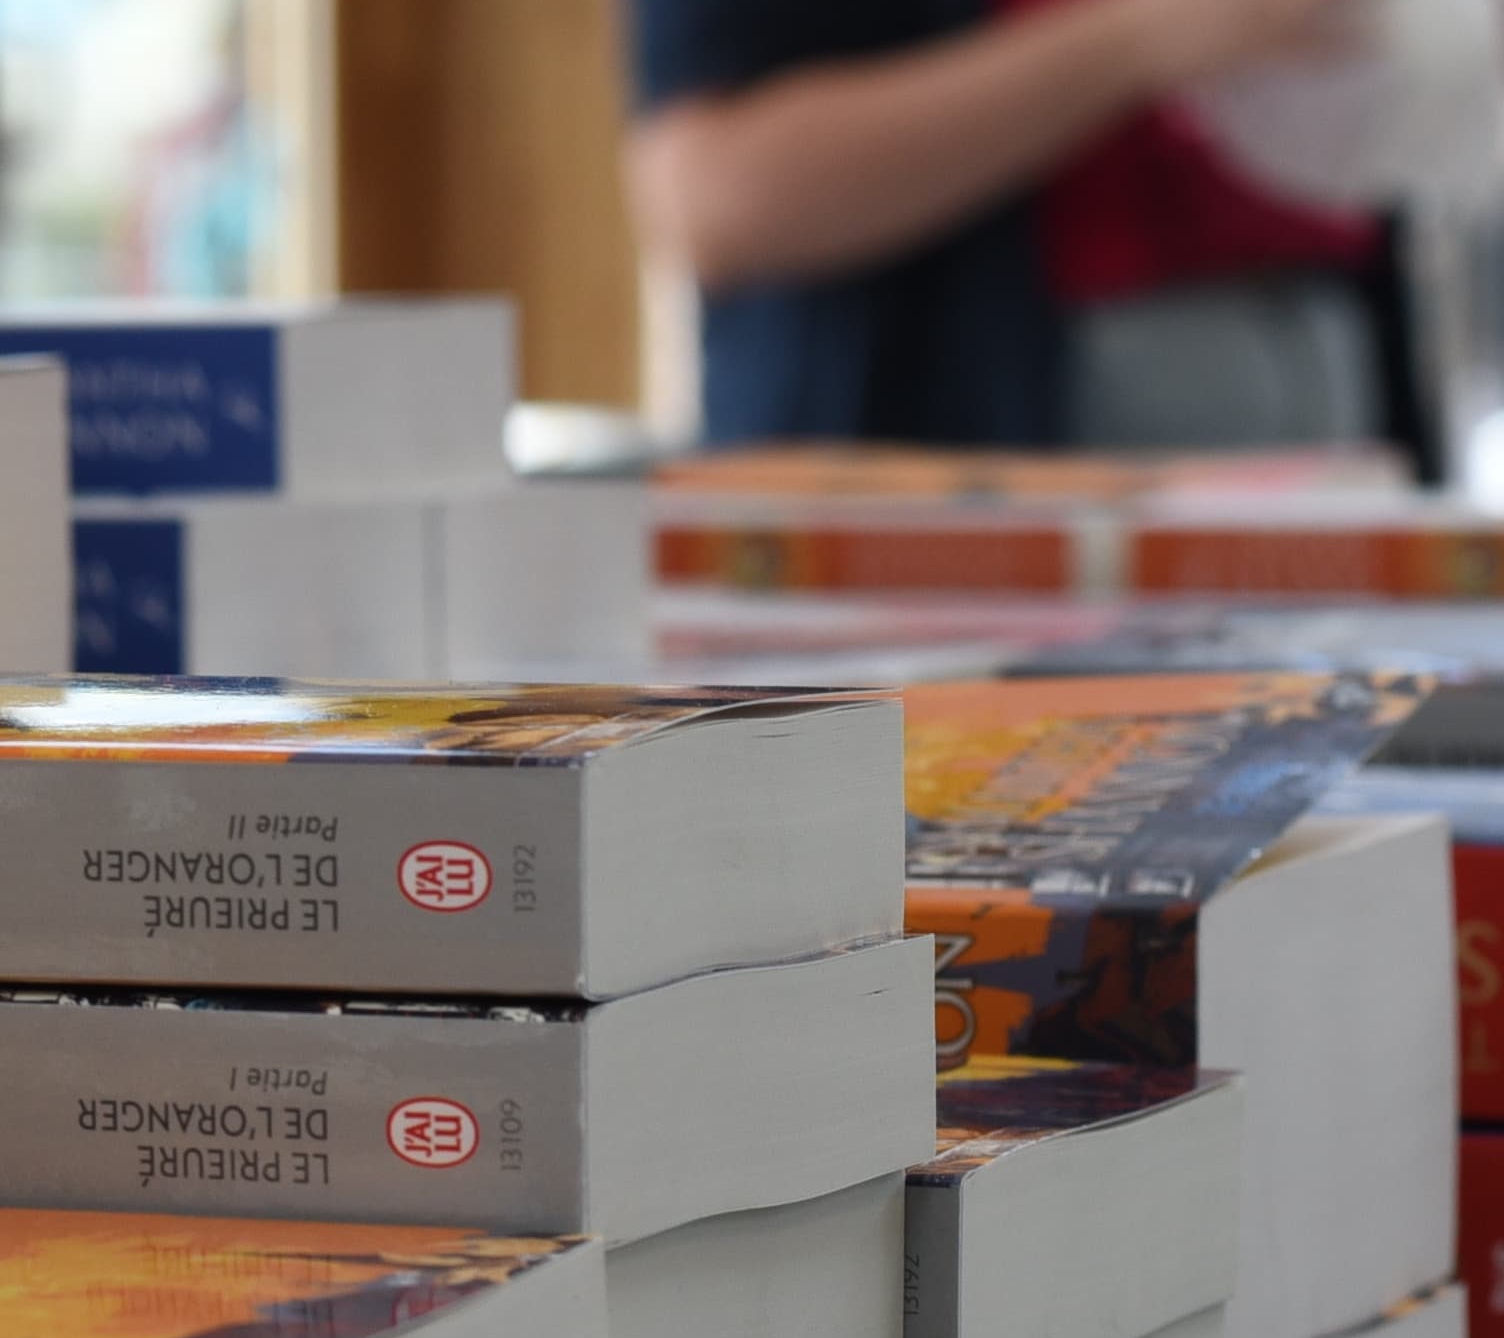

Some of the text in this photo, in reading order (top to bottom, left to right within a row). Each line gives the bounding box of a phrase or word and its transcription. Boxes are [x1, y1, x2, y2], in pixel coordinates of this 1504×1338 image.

[255, 814, 339, 843] Partie
[82, 848, 339, 889] DE L'ORANGER
[415, 854, 445, 902] J'AI
[445, 857, 475, 897] LU
[512, 842, 537, 913] 13192
[143, 896, 340, 938] LE PRIEURÉ
[247, 1067, 327, 1096] Partie
[78, 1097, 329, 1140] DE L'ORANGER
[403, 1110, 432, 1158] J'AI
[433, 1114, 463, 1153] LU
[138, 1145, 329, 1188] LE PRIEURÉ
